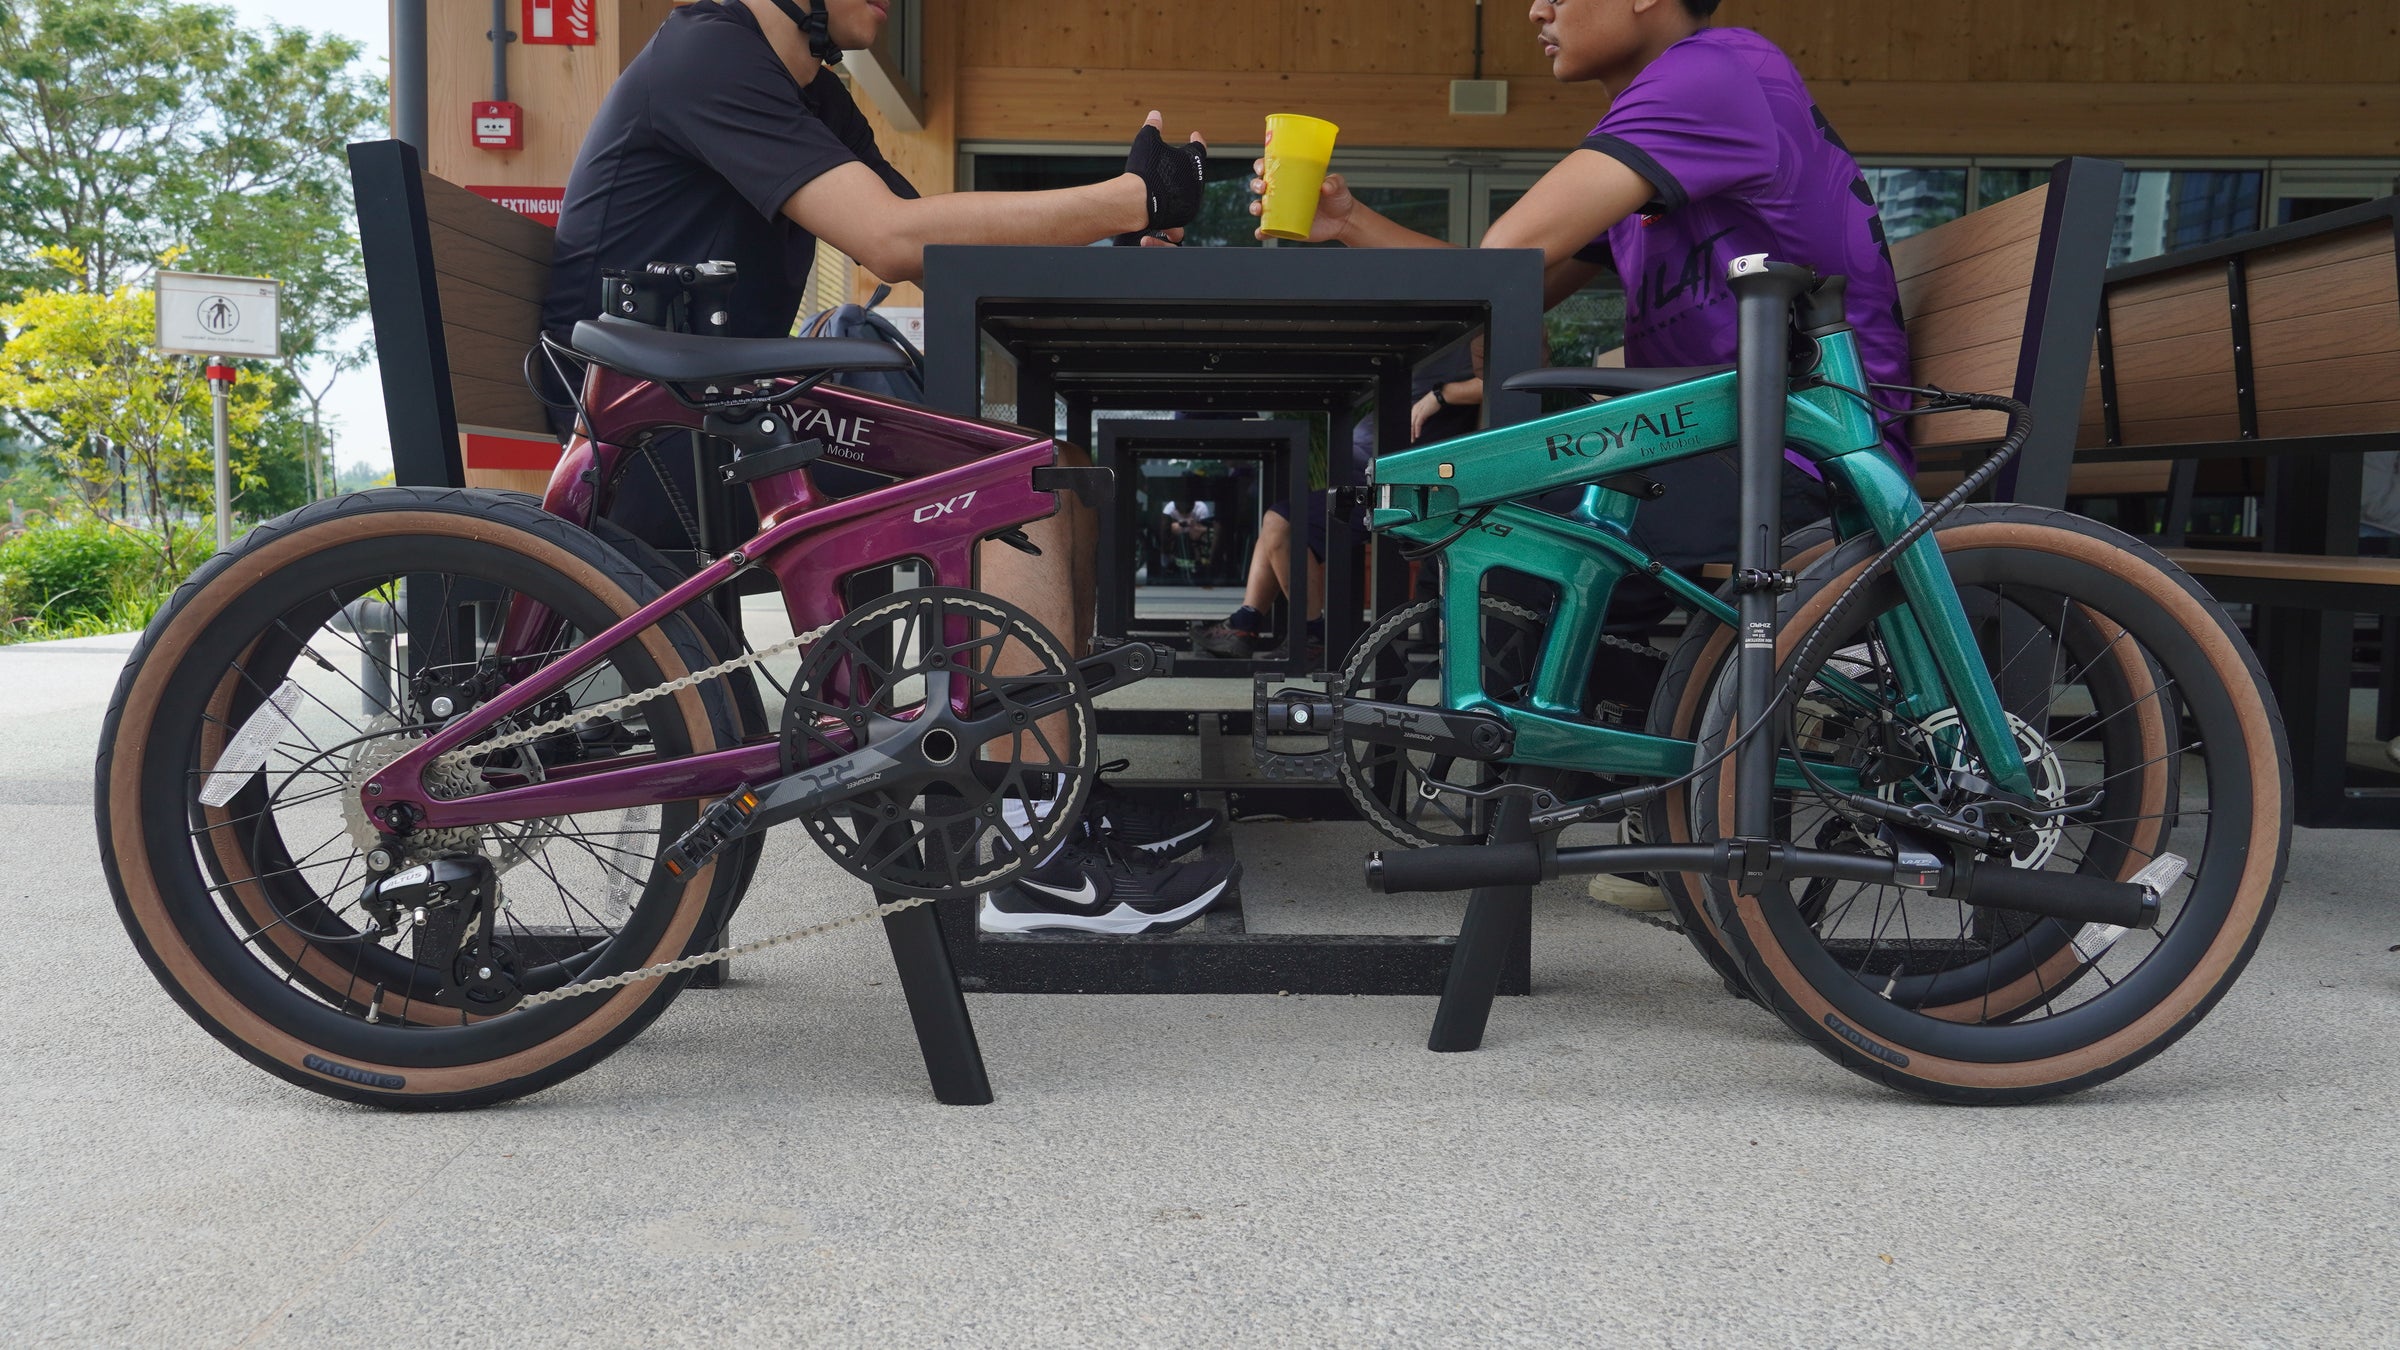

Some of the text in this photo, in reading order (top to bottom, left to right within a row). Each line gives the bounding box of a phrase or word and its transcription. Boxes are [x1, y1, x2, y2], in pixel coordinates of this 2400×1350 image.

[501, 199, 563, 213] EXTINGUI
[766, 400, 875, 447] YALE
[1545, 401, 1699, 461] ROYALE
[827, 443, 865, 462] Mobot
[1659, 435, 1700, 454] Mobot
[913, 490, 978, 523] CX7
[386, 871, 423, 889] ALTUS
[1829, 1016, 1889, 1058] INNOVA
[309, 1057, 380, 1086] INNOVA
